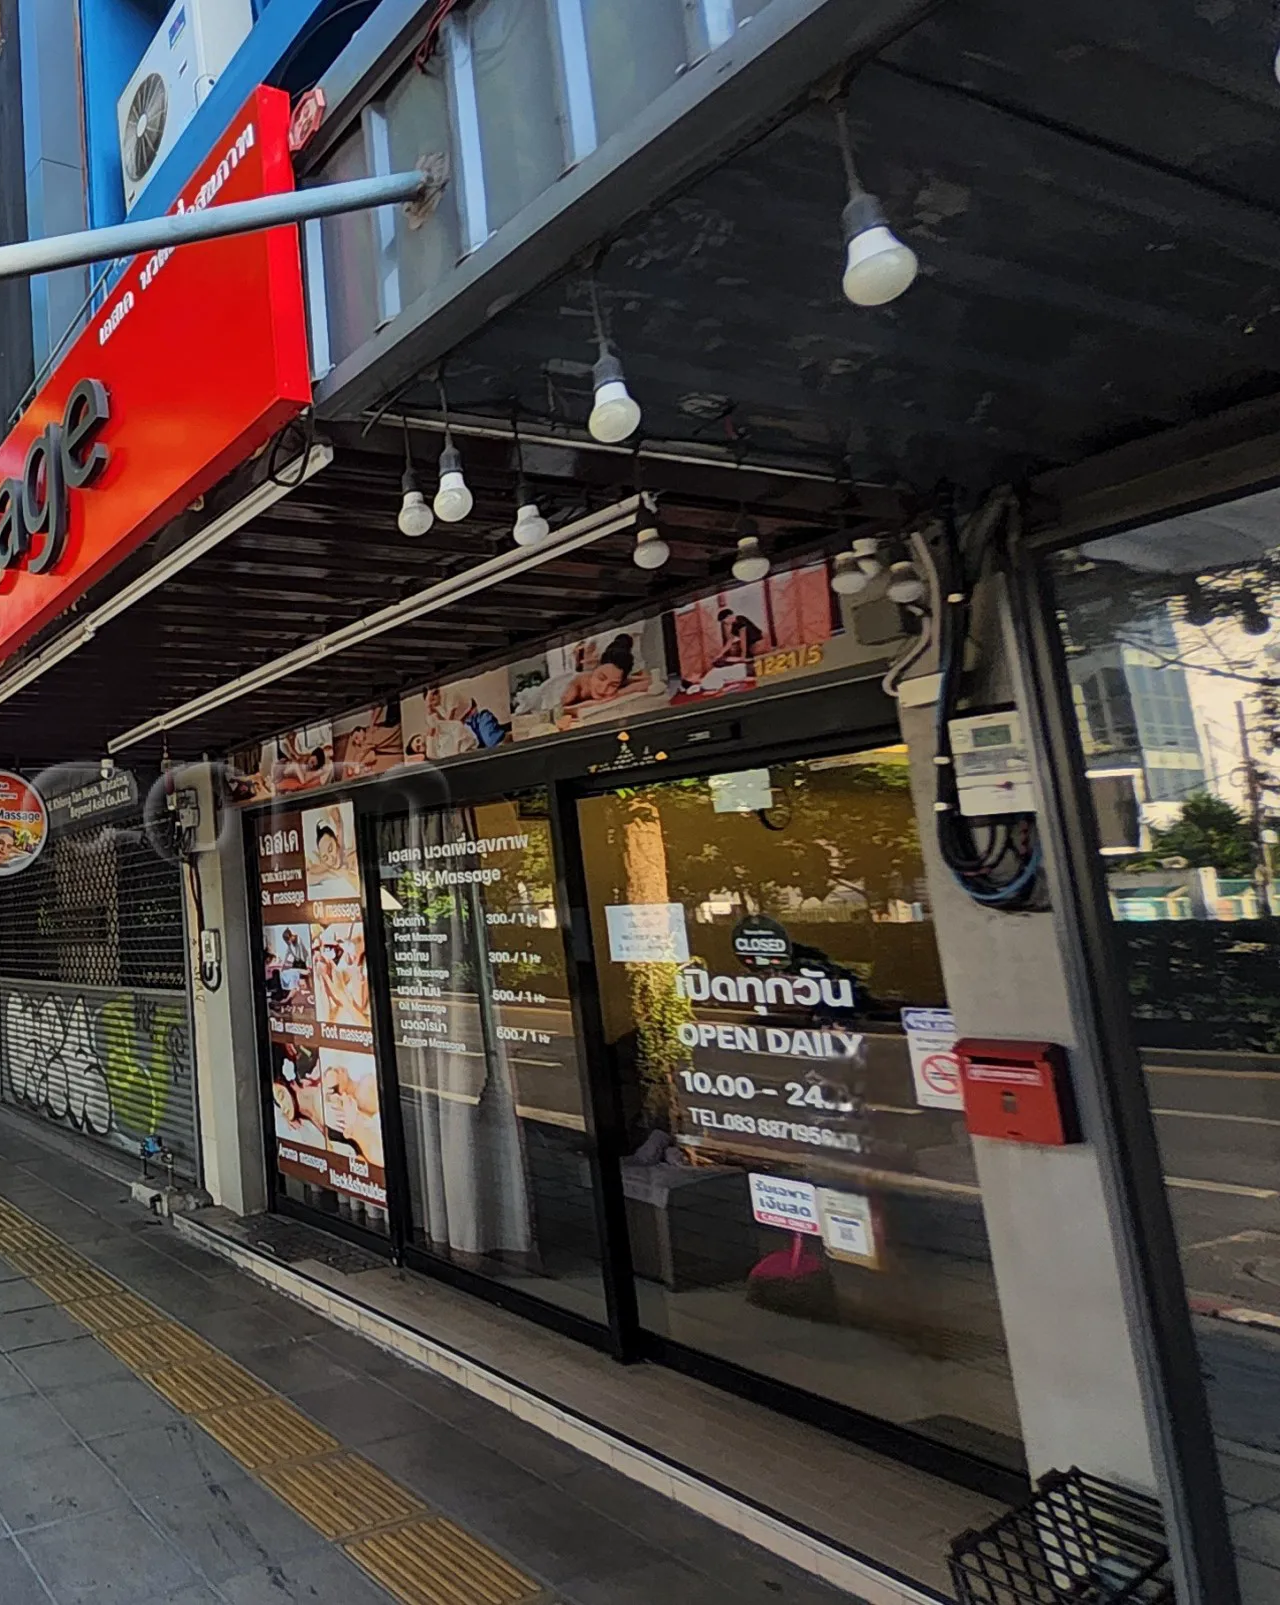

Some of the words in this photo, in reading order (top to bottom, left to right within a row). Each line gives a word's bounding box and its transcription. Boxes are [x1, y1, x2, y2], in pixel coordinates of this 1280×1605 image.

[753, 644, 824, 678] 1221/5
[70, 801, 93, 819] Beyond
[93, 796, 106, 811] Asia
[259, 829, 299, 856] เอสเค
[388, 847, 421, 863] เอสเค
[424, 832, 529, 859] นวดเพื่อสุขภาพ
[435, 867, 501, 887] Massage
[273, 890, 305, 907] massage
[312, 902, 325, 919] Oil
[325, 902, 362, 921] massage
[393, 933, 411, 943] Foot
[411, 932, 448, 944] Massage
[735, 937, 786, 952] CLOSED
[395, 967, 412, 977] Thai
[413, 966, 449, 980] Massage
[676, 967, 855, 1016] เปิดทุกวัน
[398, 1001, 410, 1011] Oil
[411, 1001, 447, 1014] Massage
[269, 1017, 284, 1032] Thai
[285, 1021, 314, 1039] massage
[320, 1022, 338, 1039] Foot
[339, 1027, 373, 1047] massage
[428, 1037, 466, 1052] Massage
[677, 1023, 759, 1052] OPEN
[767, 1028, 863, 1058] DAILY
[680, 1071, 755, 1100] 10.00
[299, 1152, 328, 1173] massage
[349, 1156, 369, 1177] Head
[755, 1179, 813, 1202] รับเฉพาะ
[759, 1195, 813, 1218] เงินสด
